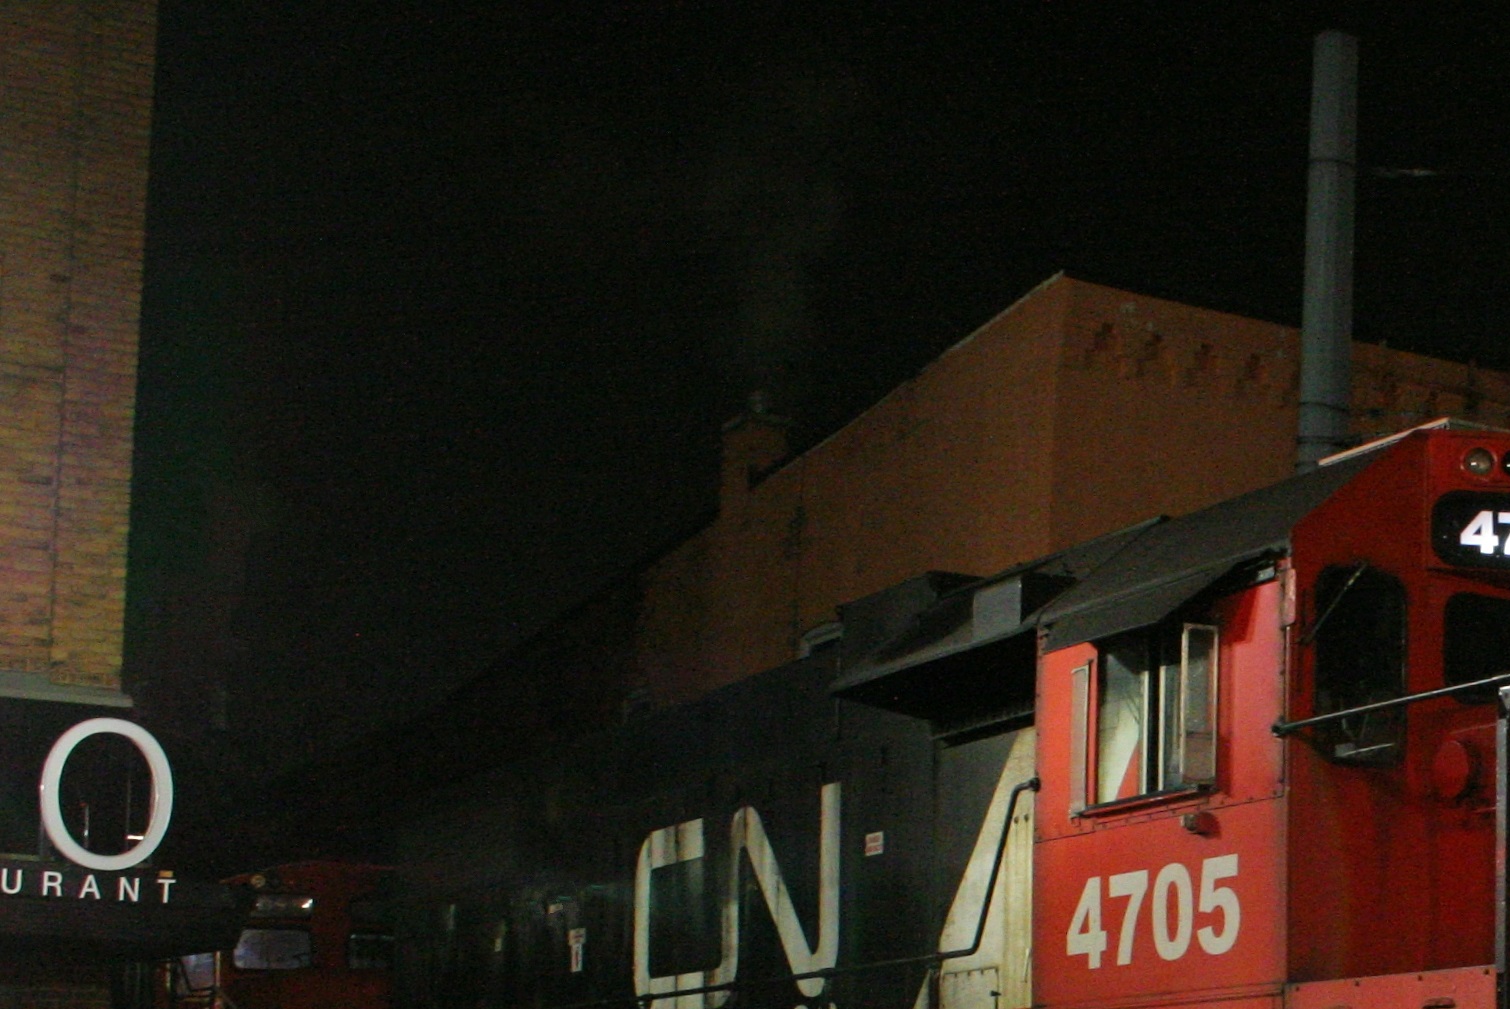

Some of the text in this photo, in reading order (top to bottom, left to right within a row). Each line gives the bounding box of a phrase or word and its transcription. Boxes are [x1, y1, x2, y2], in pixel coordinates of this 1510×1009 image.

[40, 717, 174, 871] O
[1, 867, 177, 904] URANT
[1066, 853, 1241, 970] 4705
